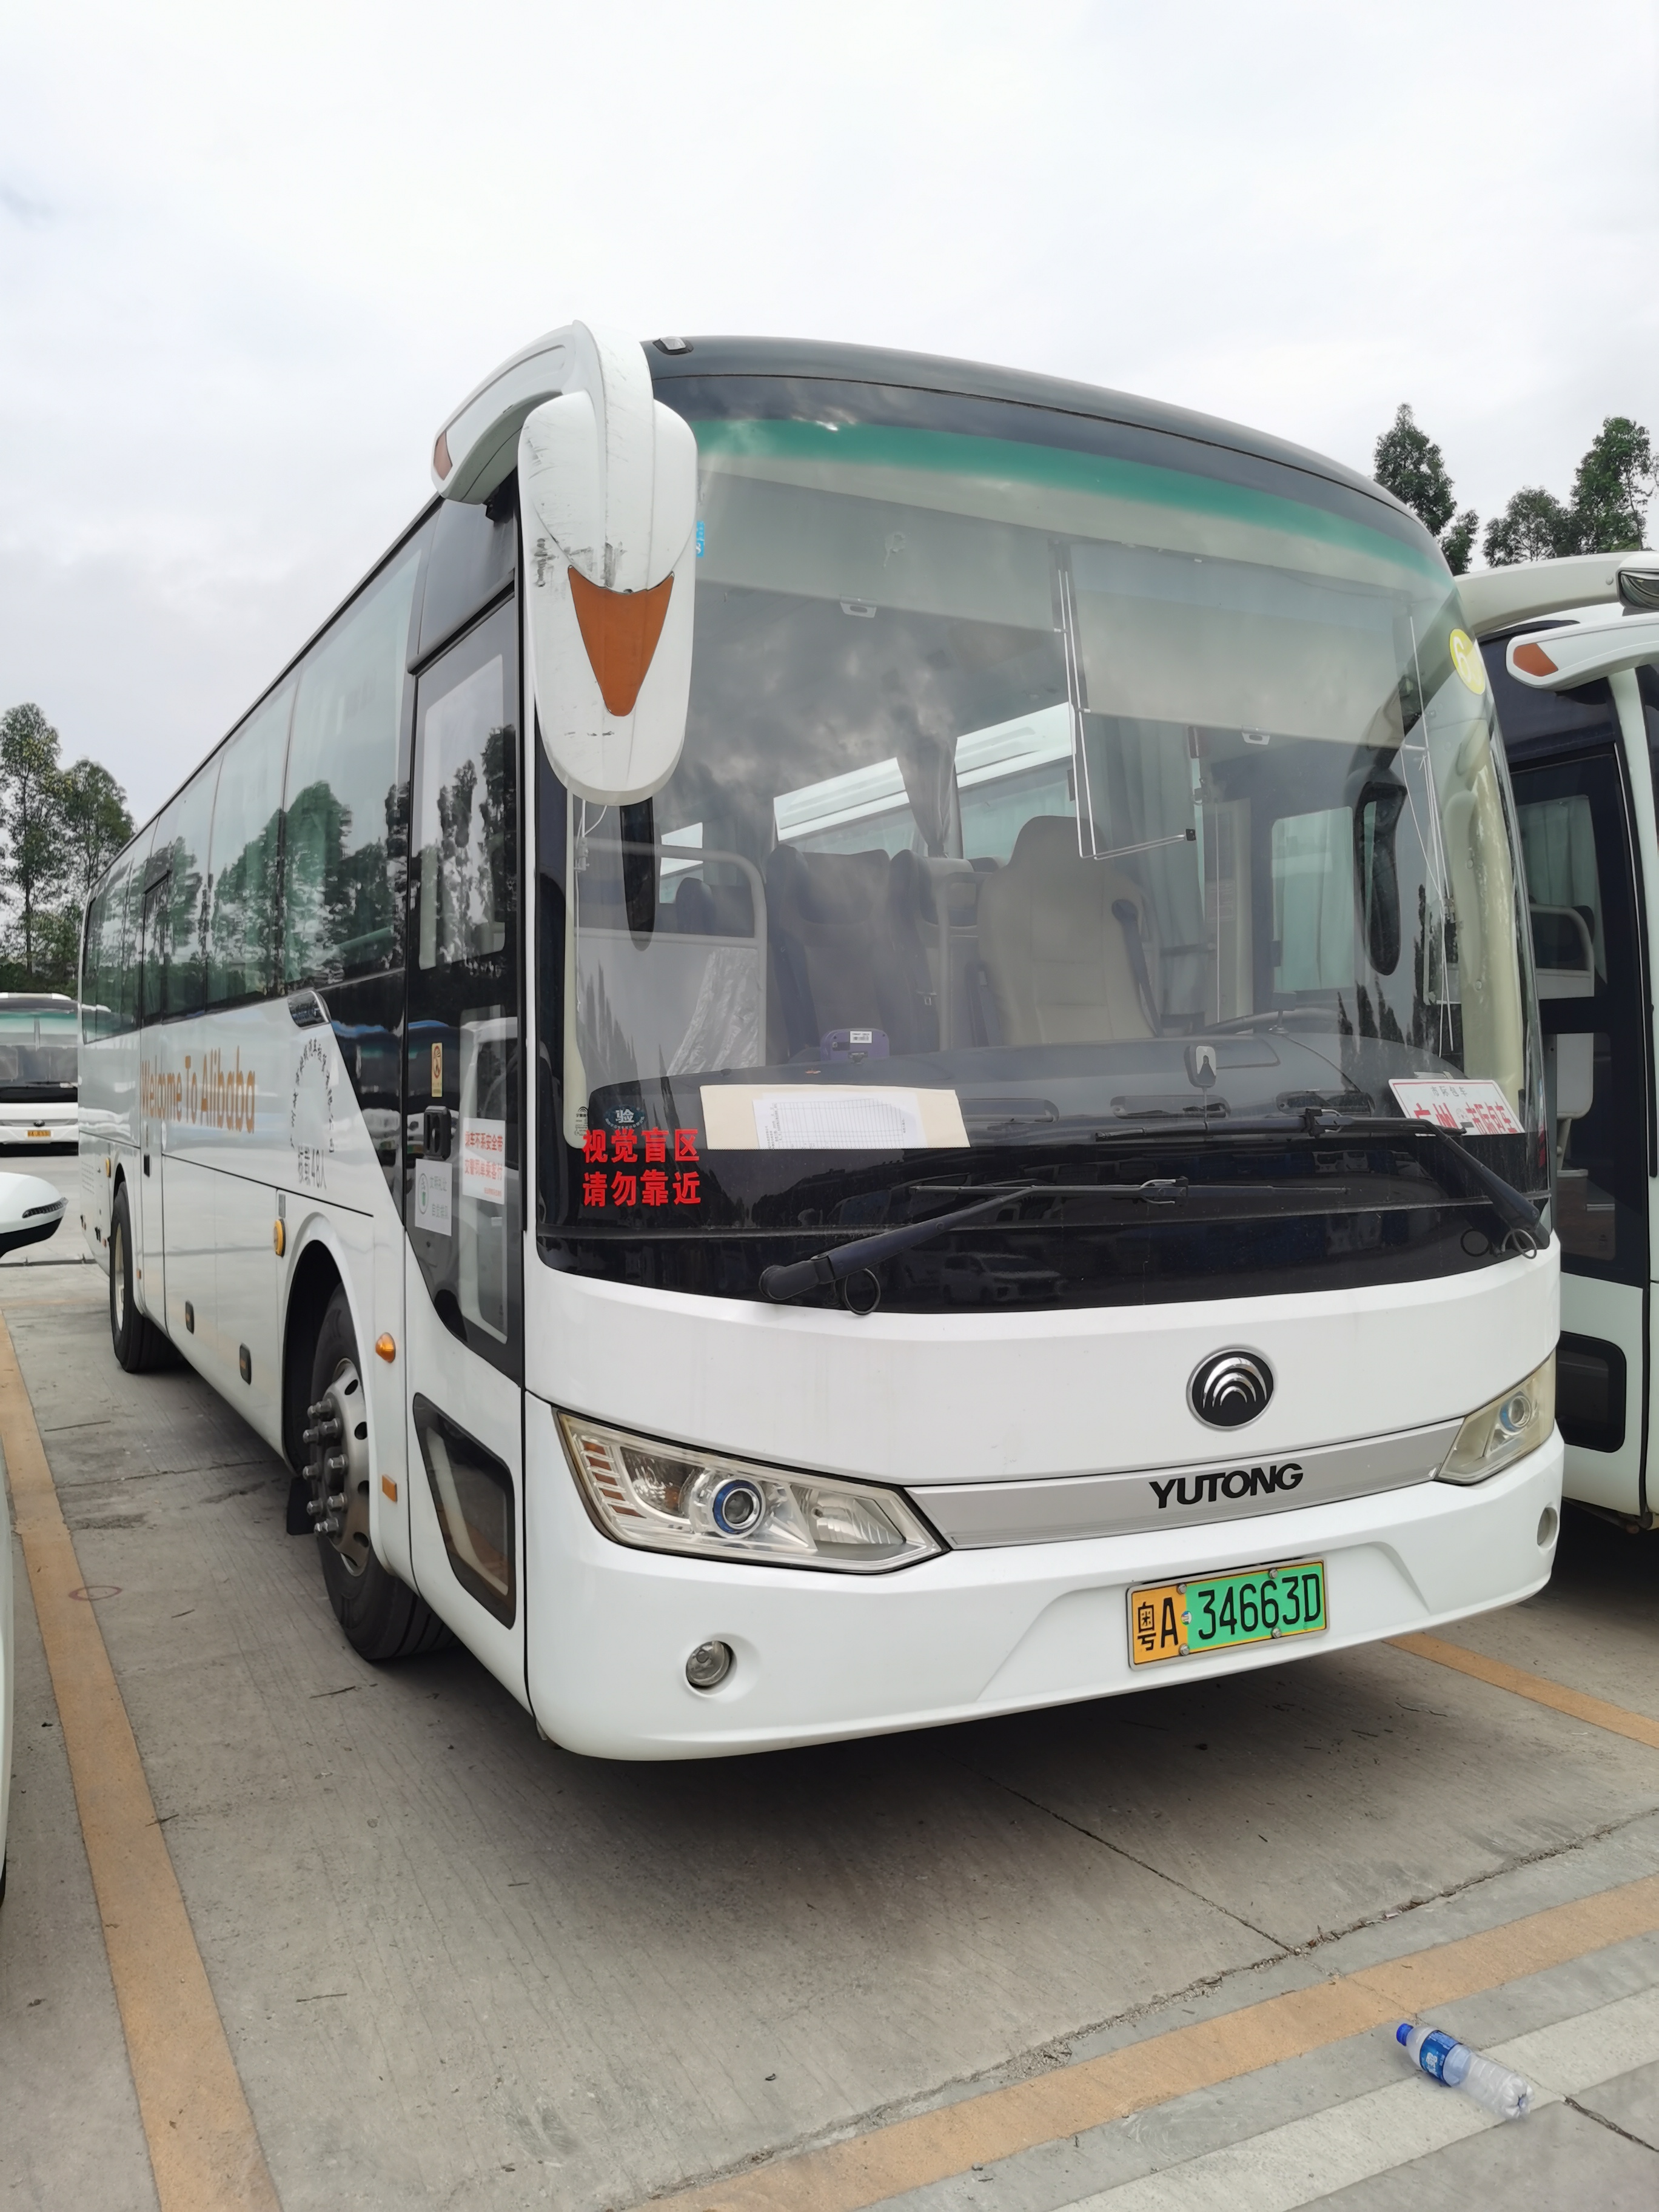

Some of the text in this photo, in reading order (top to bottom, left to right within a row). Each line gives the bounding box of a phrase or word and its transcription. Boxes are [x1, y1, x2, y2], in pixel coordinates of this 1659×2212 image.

[141, 1054, 182, 1122] Welcome
[201, 1045, 255, 1134] Alibaba
[615, 1108, 635, 1124] 验
[582, 1127, 700, 1163] 视觉盲区
[582, 1169, 701, 1207] 请勿靠近
[1149, 1463, 1304, 1509] YUTONG
